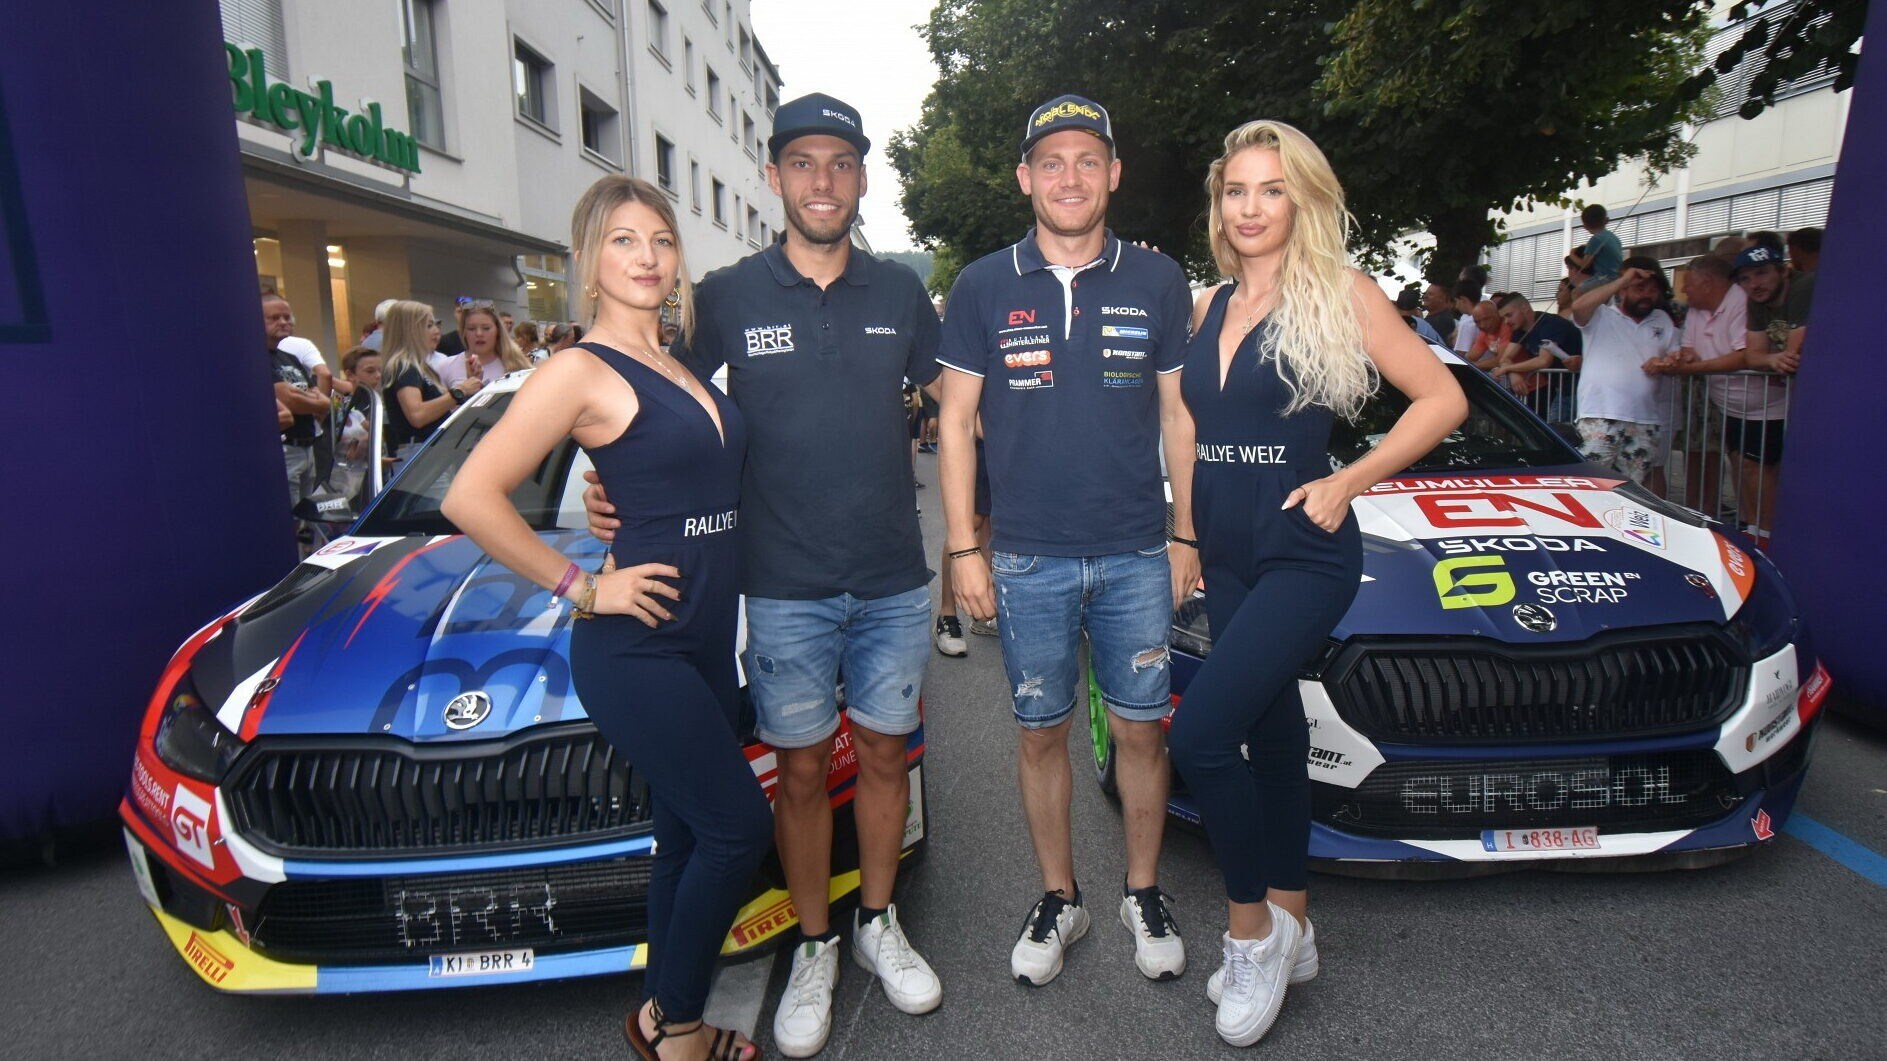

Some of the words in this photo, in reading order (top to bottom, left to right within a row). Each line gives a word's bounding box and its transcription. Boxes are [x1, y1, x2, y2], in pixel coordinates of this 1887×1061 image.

[745, 329, 794, 351] BRR
[1004, 350, 1048, 364] evers
[1008, 378, 1042, 387] PRAMMER
[1196, 442, 1236, 463] RALLYE
[1238, 445, 1287, 464] WEIZ
[1364, 478, 1600, 492] EUMÜLLER
[1412, 491, 1605, 529] EN
[683, 510, 734, 537] RALLYE
[1527, 570, 1627, 586] GREEN
[1536, 587, 1628, 604] SCRAP
[1401, 765, 1688, 814] EUROSOL
[1530, 829, 1596, 848] 838-AG
[183, 930, 235, 985] PIRELLI
[479, 953, 514, 971] BRR
[521, 951, 532, 967] 4
